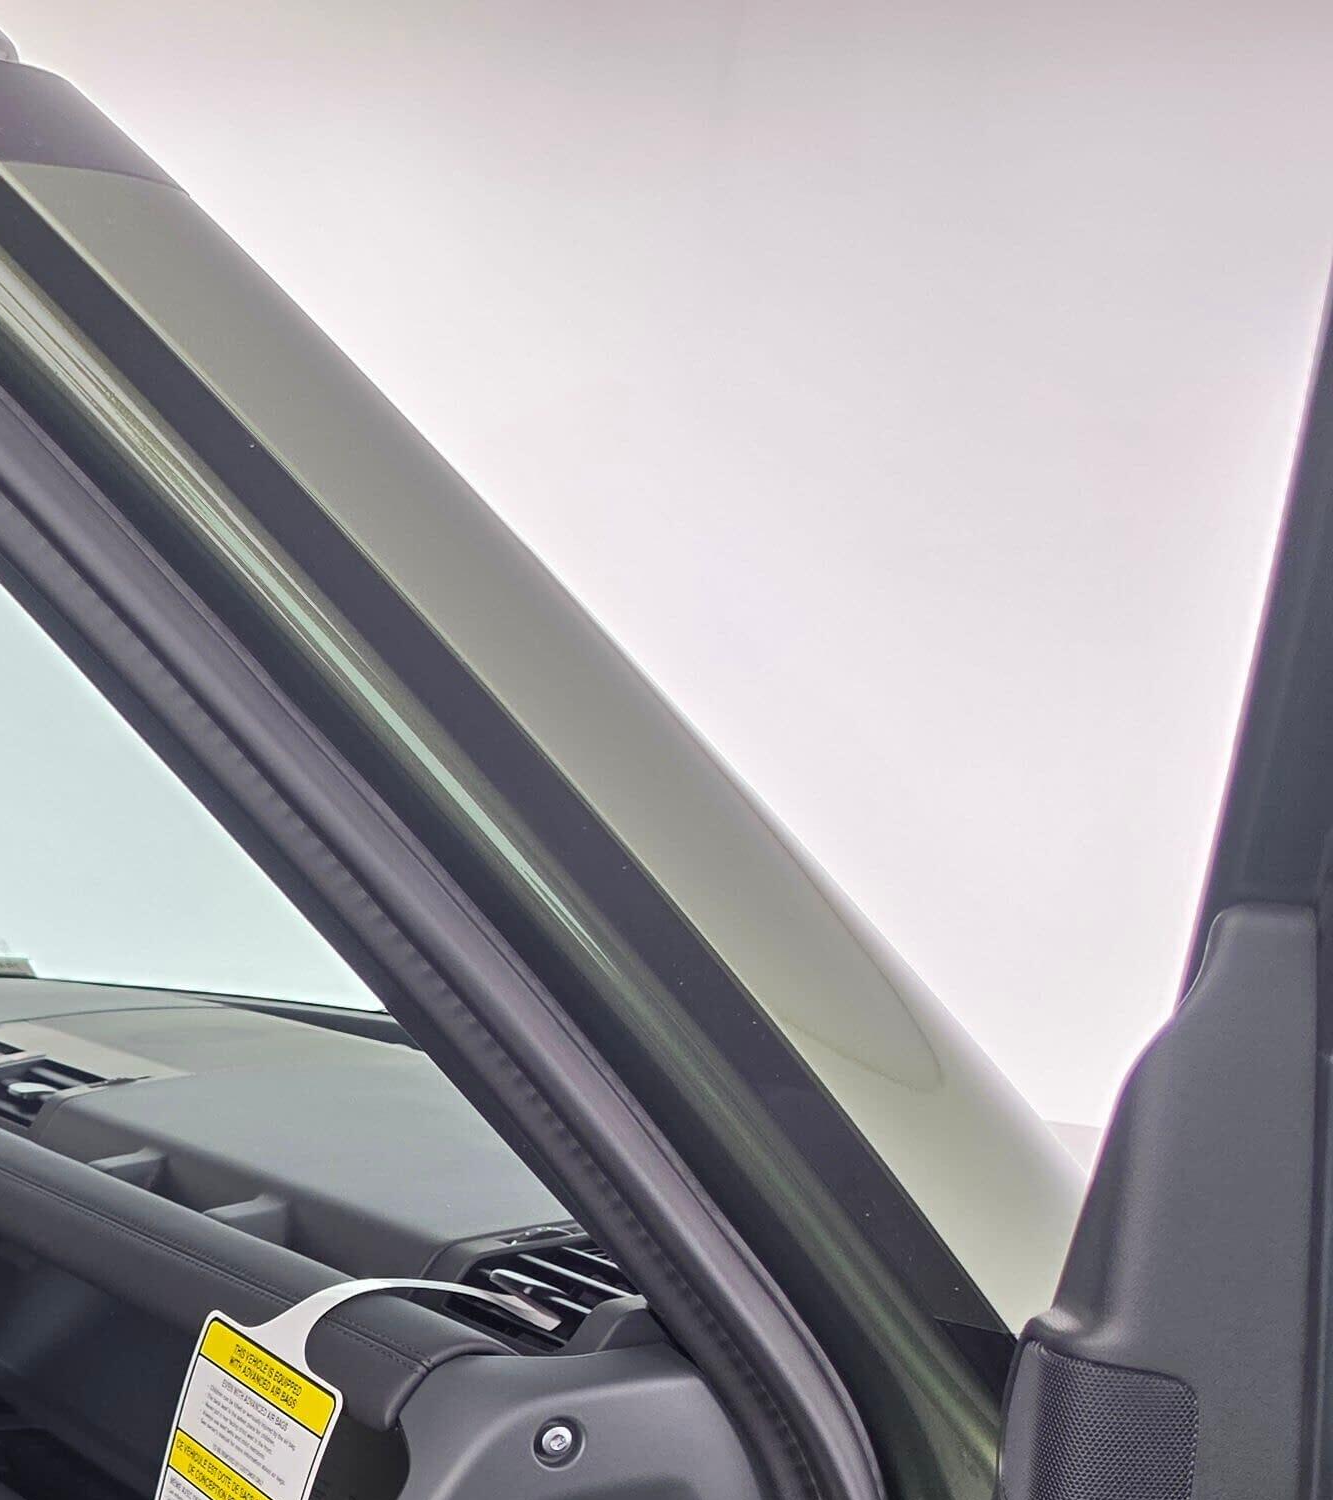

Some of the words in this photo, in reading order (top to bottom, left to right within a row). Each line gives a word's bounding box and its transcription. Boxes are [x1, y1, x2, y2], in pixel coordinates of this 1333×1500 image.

[228, 1355, 243, 1373] WITH
[241, 1364, 271, 1392] ADVANCED
[269, 1383, 281, 1399] AIR
[279, 1390, 297, 1410] BAGS
[233, 1342, 248, 1360] THIS
[244, 1350, 268, 1374] VEHICLE
[266, 1365, 275, 1379] IS
[272, 1369, 302, 1397] EQUIPPED
[242, 1393, 267, 1417] ADVANCED
[274, 1415, 288, 1432] BAGS
[186, 1462, 196, 1477] DE
[206, 1461, 218, 1478] EST
[230, 1480, 240, 1495] DE
